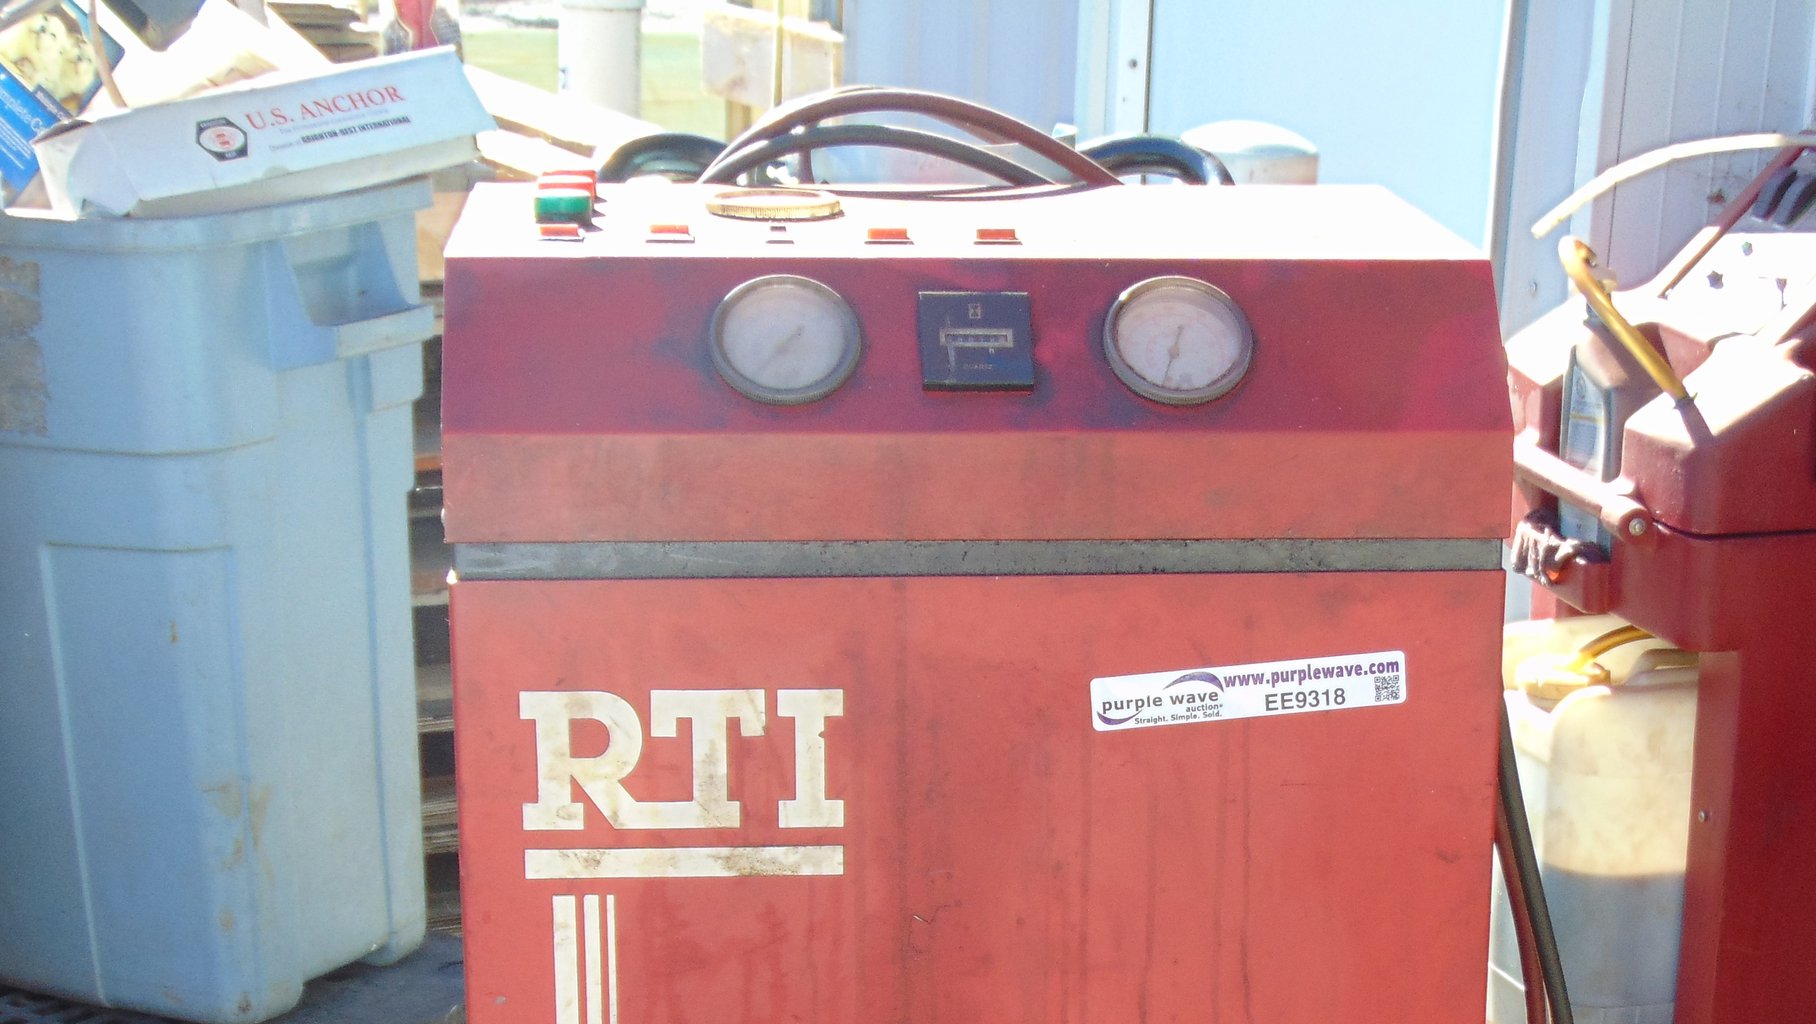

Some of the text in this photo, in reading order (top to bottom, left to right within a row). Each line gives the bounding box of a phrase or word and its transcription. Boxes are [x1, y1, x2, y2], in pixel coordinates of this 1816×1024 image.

[244, 107, 294, 130] U.S.
[300, 86, 405, 120] ANCHOR
[1223, 660, 1400, 688] www.purplewave.com
[1102, 691, 1219, 714] purple wave
[1265, 688, 1346, 711] EE9318
[1134, 714, 1168, 724] Straight.
[1170, 713, 1200, 721] Simple.
[519, 688, 844, 830] RTI
